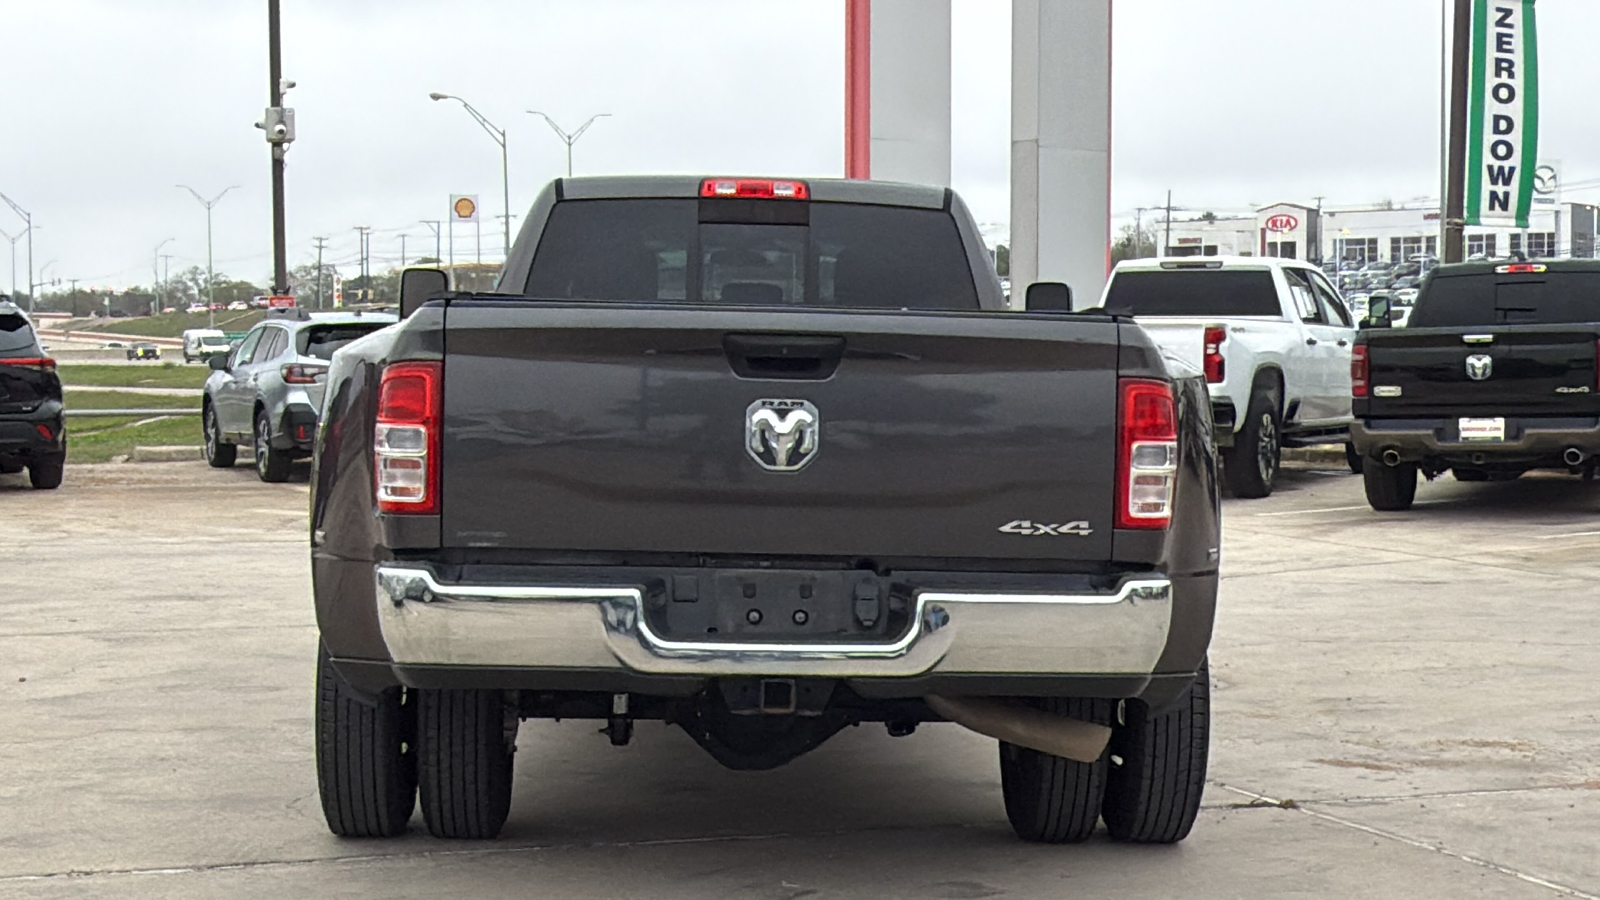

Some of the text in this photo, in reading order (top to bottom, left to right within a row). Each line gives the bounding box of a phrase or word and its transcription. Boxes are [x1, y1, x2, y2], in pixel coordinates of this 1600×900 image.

[1487, 7, 1516, 211] ZERO DOWN
[1270, 217, 1294, 229] KIA
[761, 400, 805, 408] RAM
